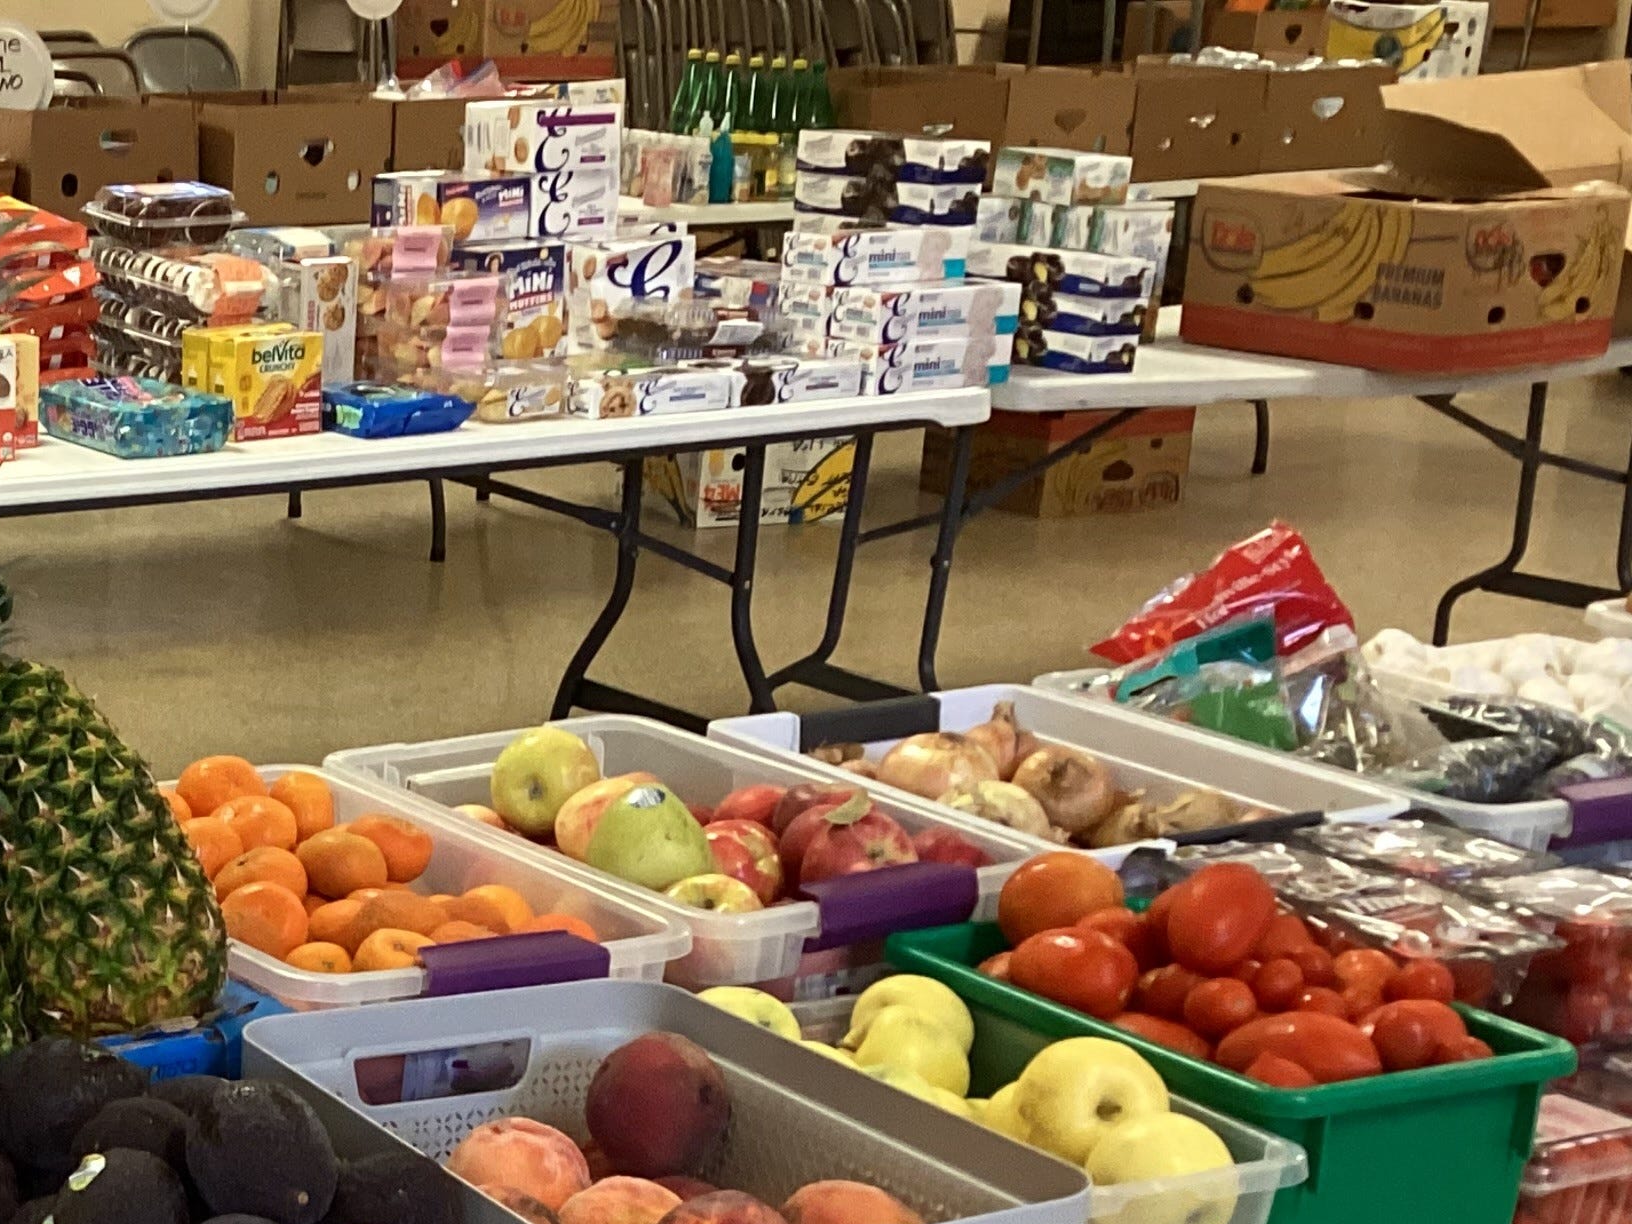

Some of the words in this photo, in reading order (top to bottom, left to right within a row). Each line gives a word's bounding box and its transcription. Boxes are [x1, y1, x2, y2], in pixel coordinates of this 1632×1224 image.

[868, 248, 896, 262] mini
[1376, 262, 1445, 288] PREMIUM
[508, 271, 554, 300] MINI
[918, 306, 947, 321] mini
[251, 338, 306, 364] belVita
[258, 361, 297, 374] CRUNCHY
[913, 356, 941, 371] mini
